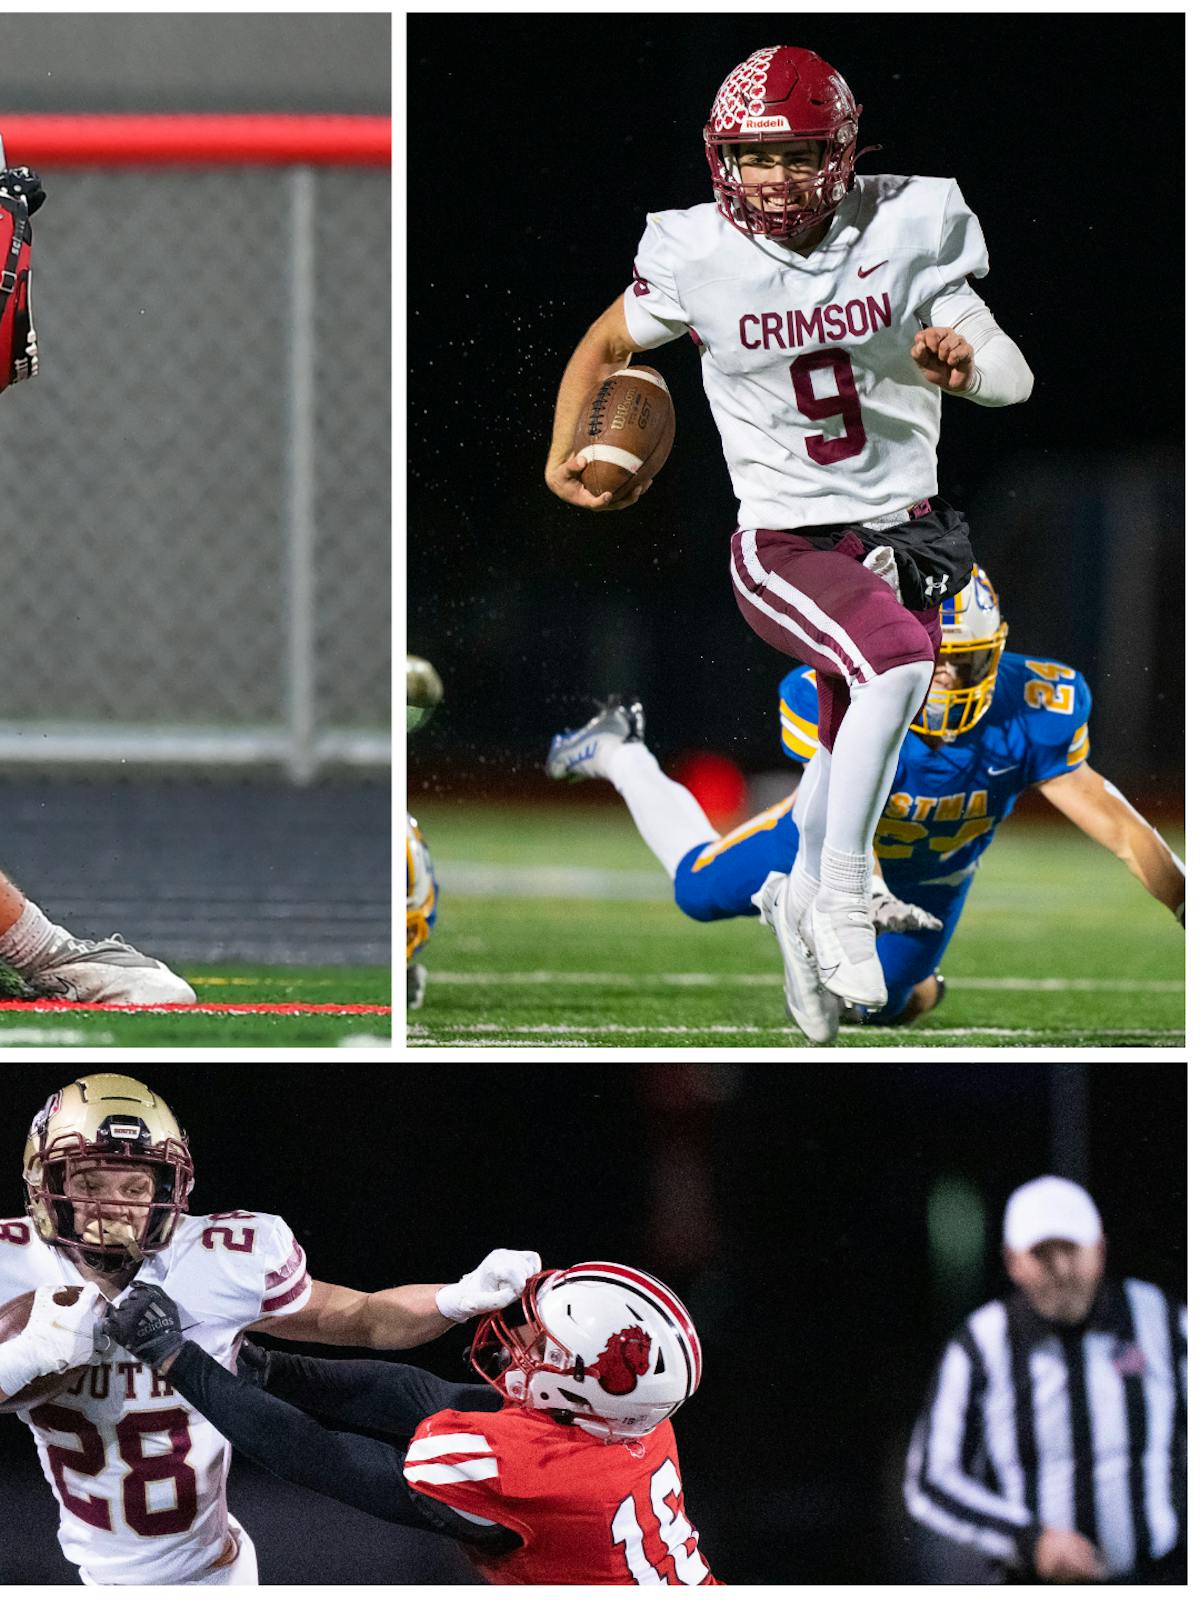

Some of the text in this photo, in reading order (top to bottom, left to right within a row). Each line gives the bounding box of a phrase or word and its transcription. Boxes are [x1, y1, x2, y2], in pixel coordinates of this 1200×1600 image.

[746, 119, 784, 128] Riddell
[739, 292, 892, 351] CRIMSON
[611, 387, 637, 431] Wilson
[789, 347, 868, 466] 9
[1024, 659, 1076, 715] 24
[885, 789, 989, 822] STMA
[137, 1315, 175, 1338] adidas
[66, 1361, 174, 1400] UTH
[28, 1402, 199, 1538] 28
[611, 1456, 712, 1585] 16
